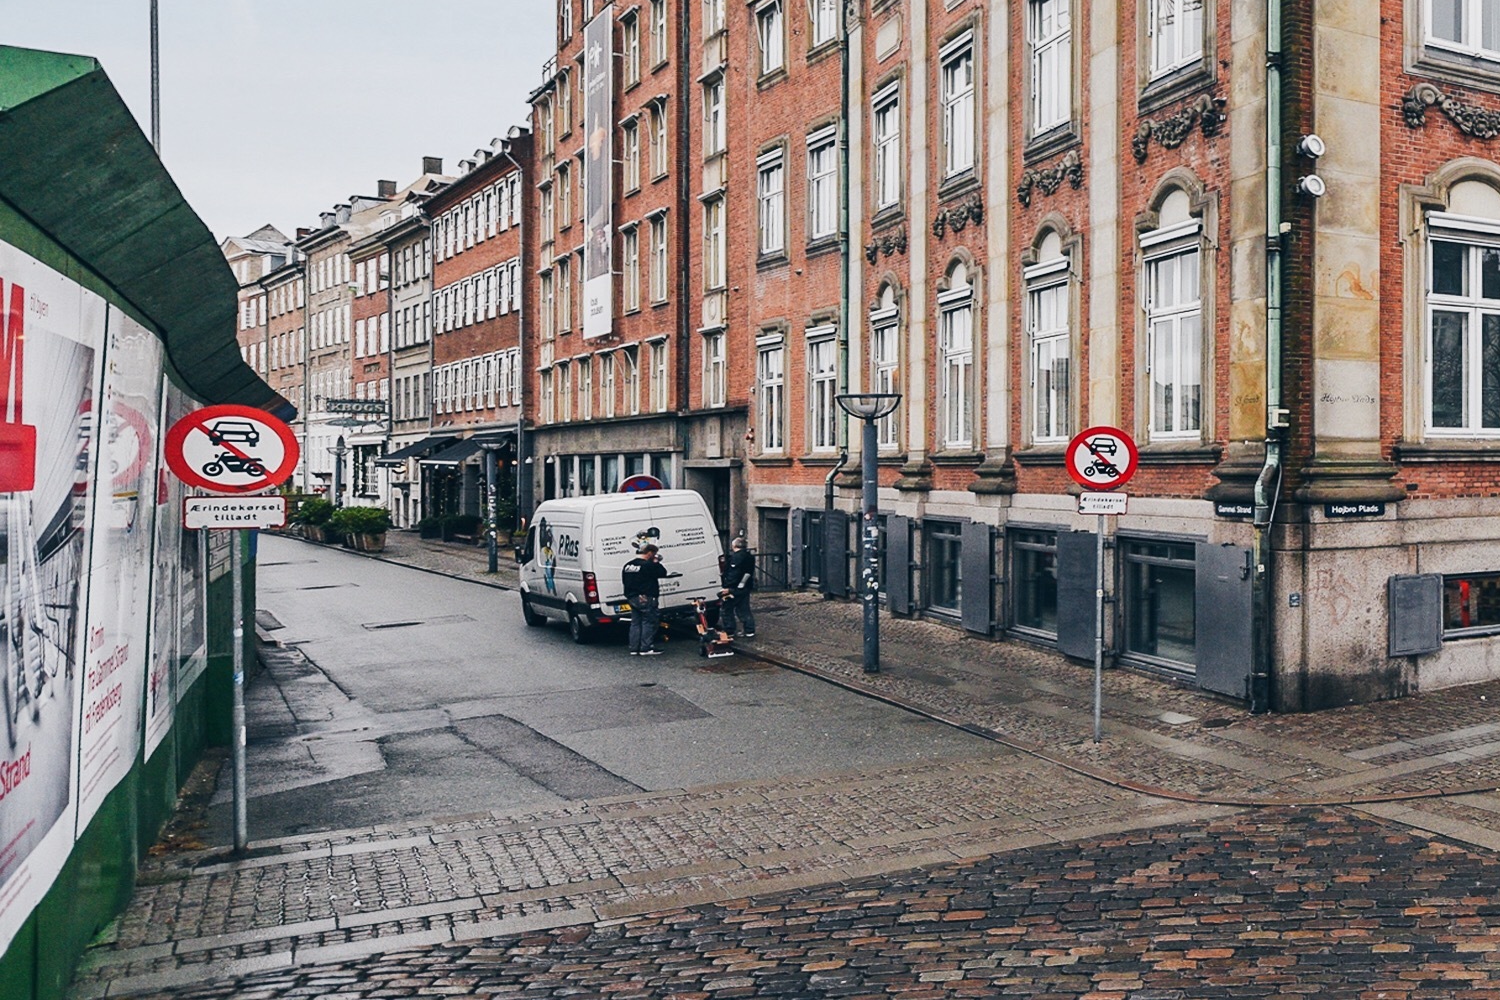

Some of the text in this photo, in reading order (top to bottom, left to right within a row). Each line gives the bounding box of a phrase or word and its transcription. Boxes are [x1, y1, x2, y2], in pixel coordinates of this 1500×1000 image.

[190, 504, 281, 512] Ærindekørsel
[1331, 504, 1379, 514] Højbro Plads
